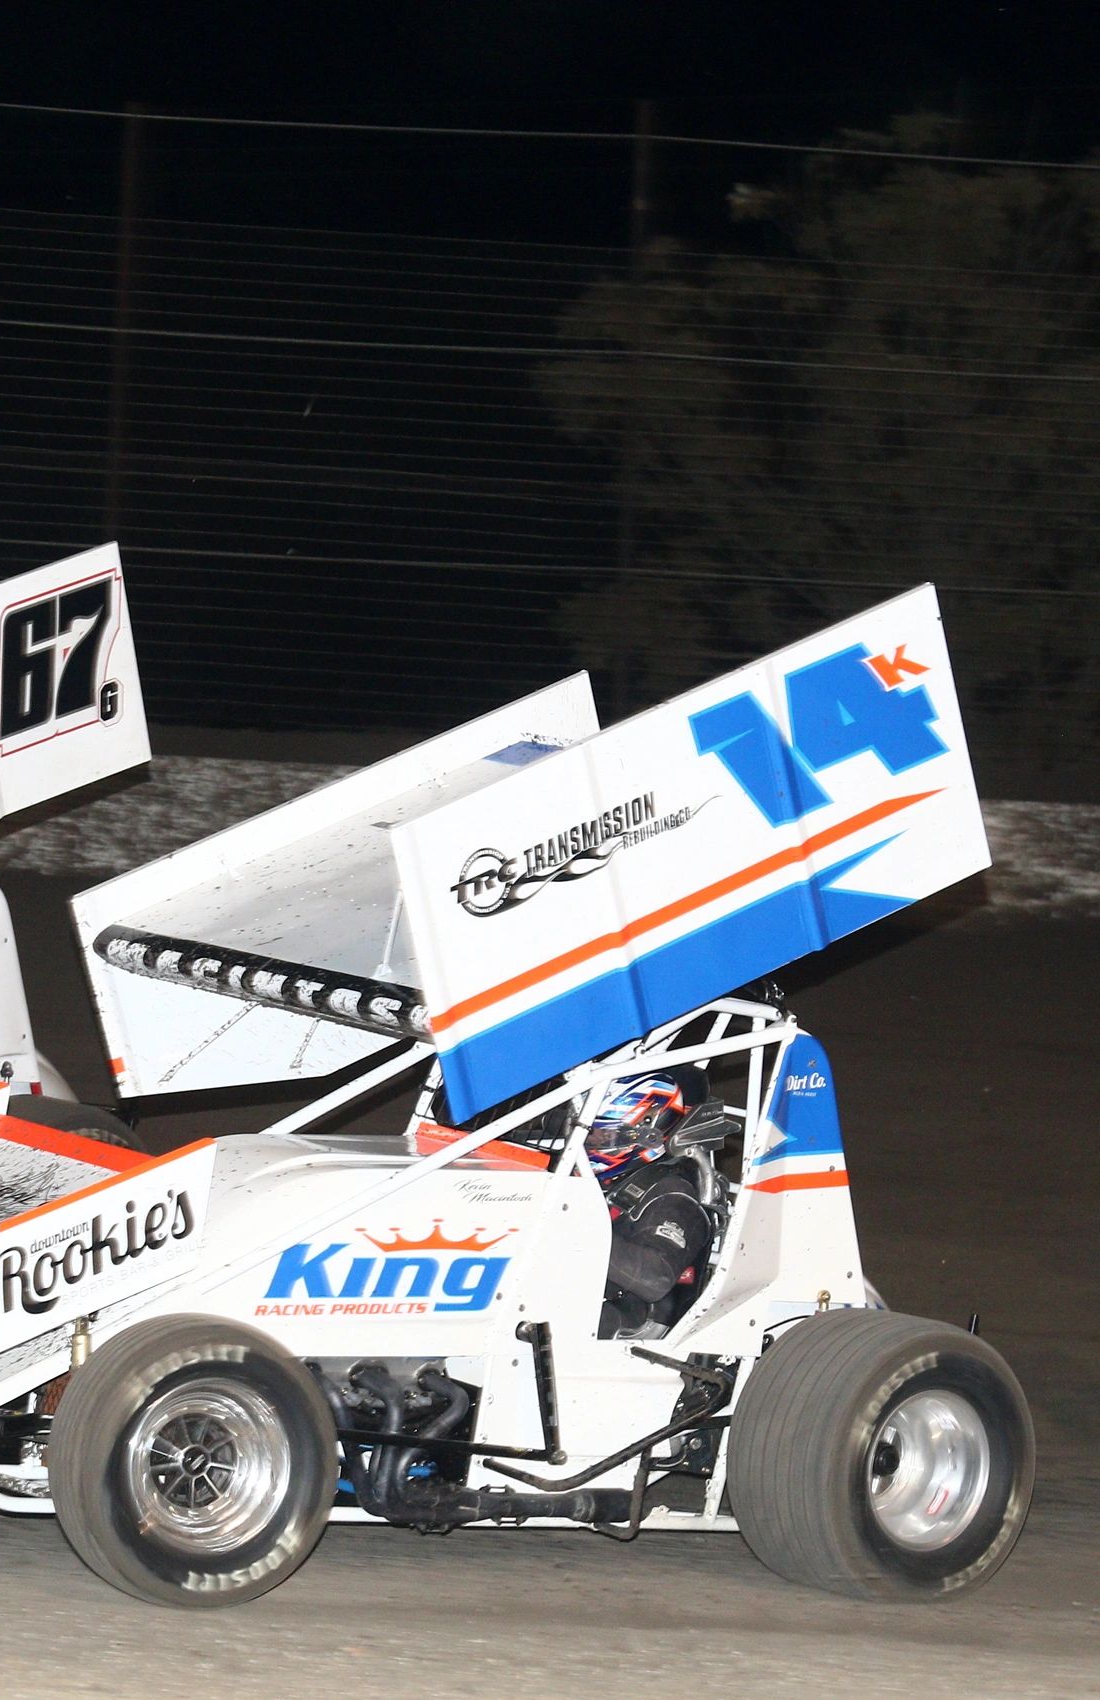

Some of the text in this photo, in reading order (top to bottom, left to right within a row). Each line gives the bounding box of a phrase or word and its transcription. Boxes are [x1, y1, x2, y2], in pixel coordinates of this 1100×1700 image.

[0, 576, 112, 741] 67
[866, 643, 932, 690] K
[687, 641, 951, 829] 14
[523, 791, 656, 878] TRANSMISSION
[449, 857, 518, 904] TRC
[786, 1074, 808, 1091] Dirt
[30, 1221, 90, 1254] downtown
[263, 1242, 512, 1312] King
[254, 1302, 429, 1317] RACING PRODUCTS
